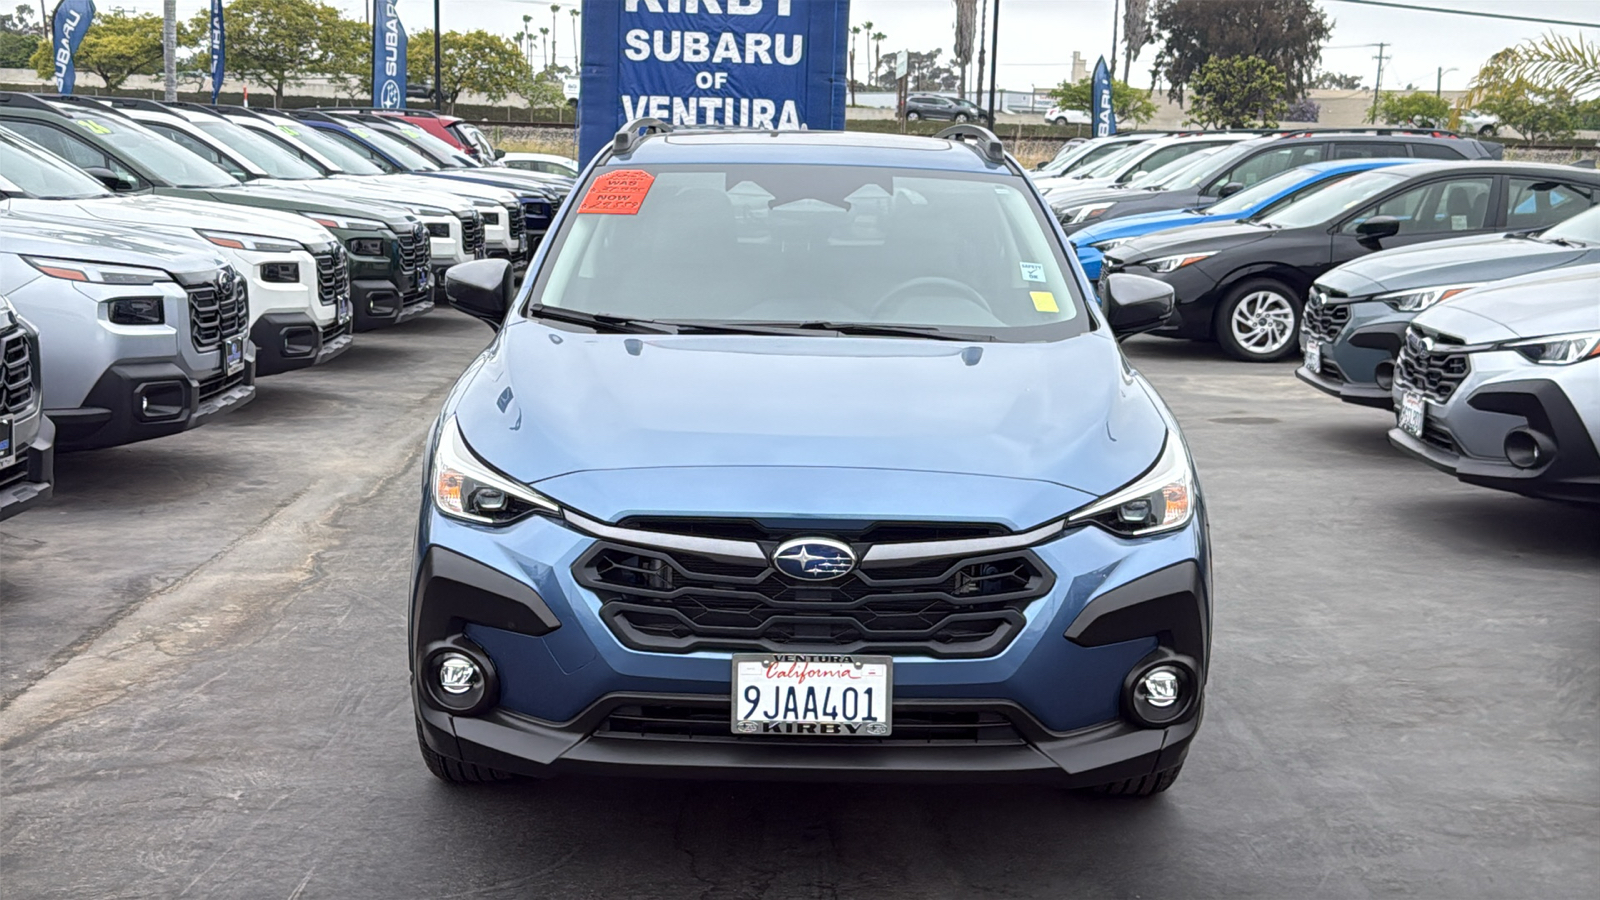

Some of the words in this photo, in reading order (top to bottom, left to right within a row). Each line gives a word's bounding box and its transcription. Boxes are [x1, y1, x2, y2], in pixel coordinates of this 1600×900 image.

[385, 0, 398, 77] SUBAR
[624, 29, 803, 66] SUBARU
[695, 71, 728, 90] OF
[773, 655, 854, 664] VENTURA
[766, 662, 862, 685] California
[743, 685, 878, 721] 9JAA401
[762, 721, 863, 735] KIRBY
